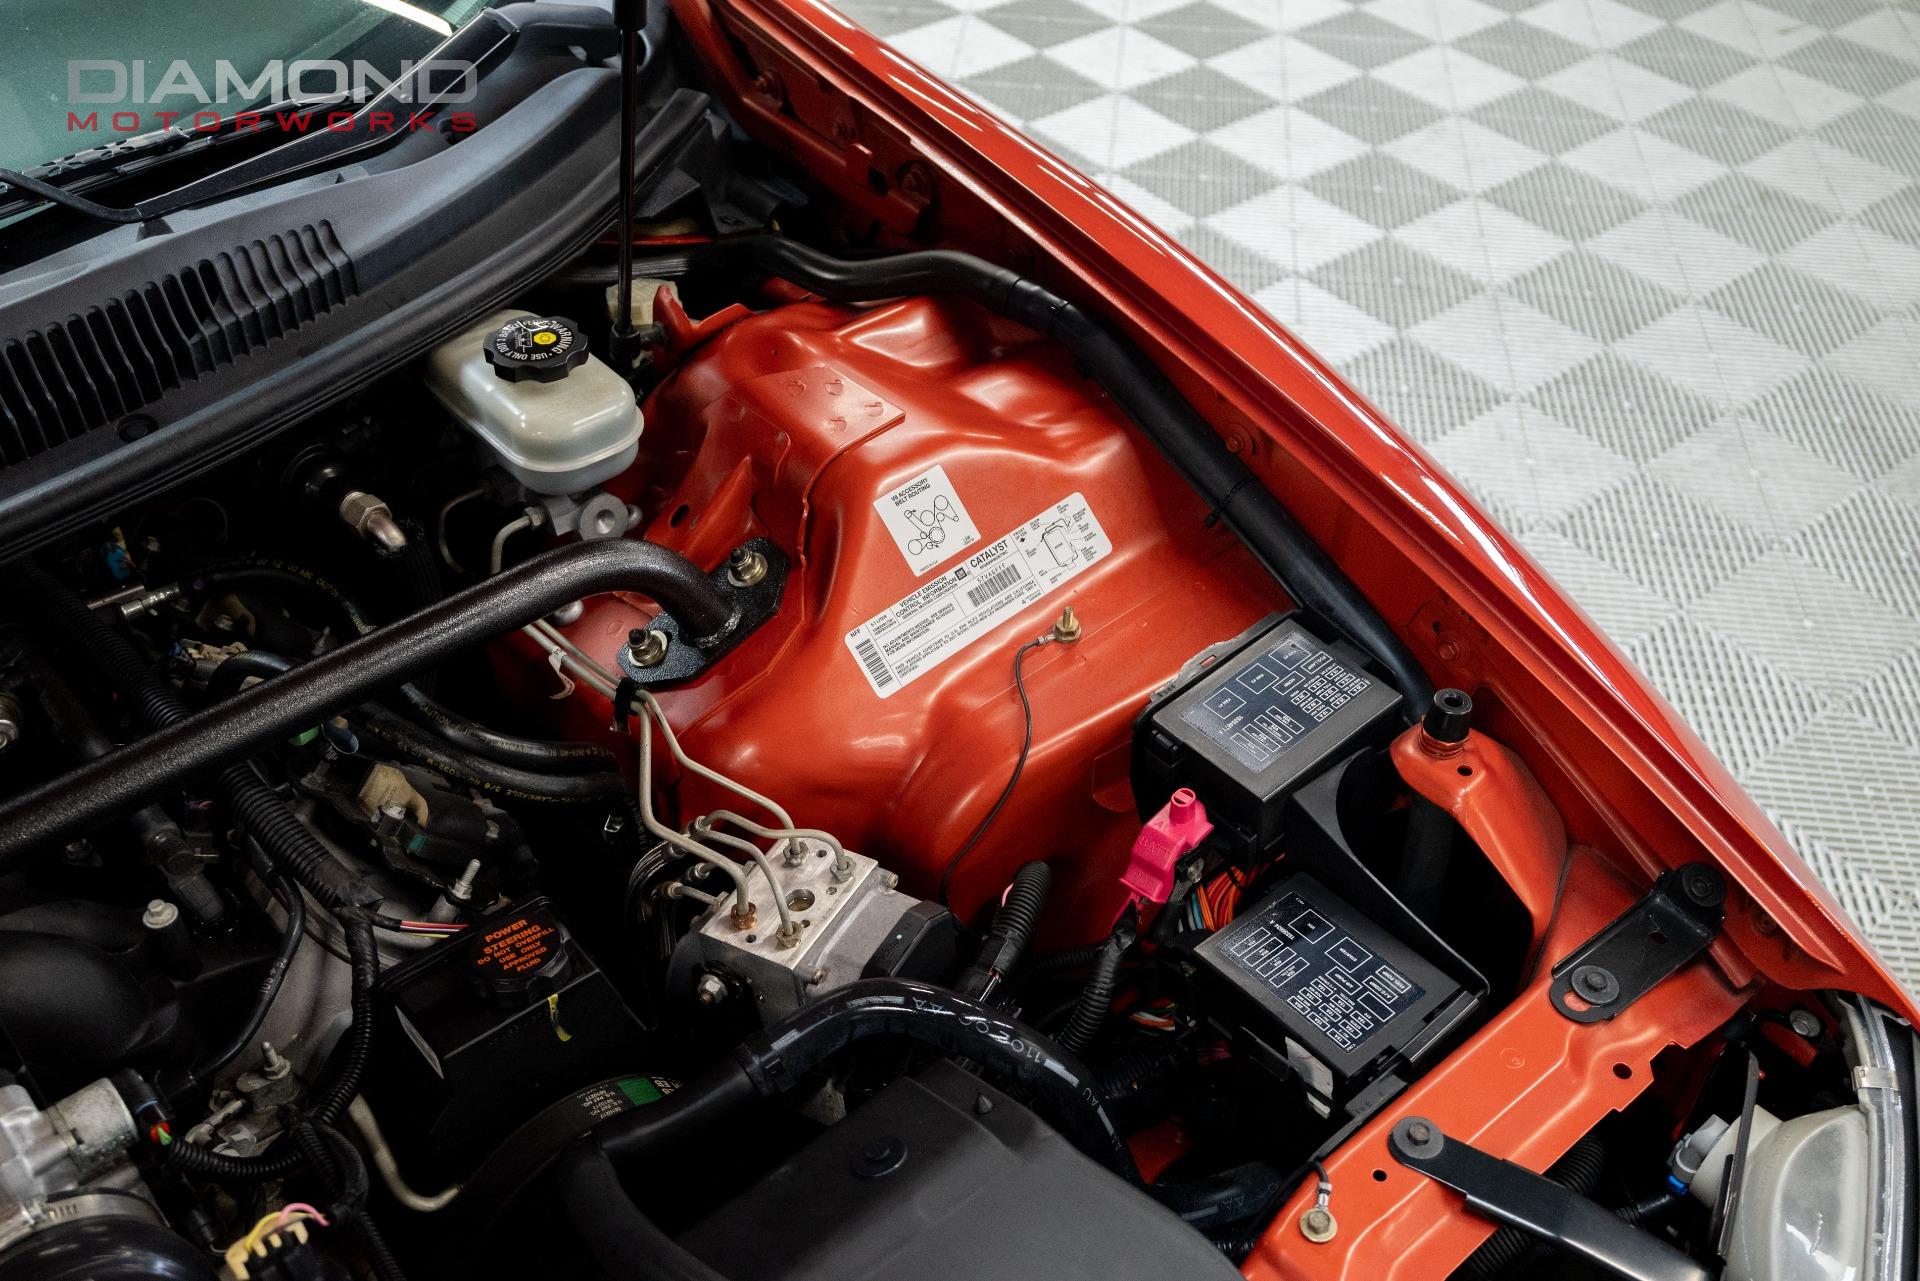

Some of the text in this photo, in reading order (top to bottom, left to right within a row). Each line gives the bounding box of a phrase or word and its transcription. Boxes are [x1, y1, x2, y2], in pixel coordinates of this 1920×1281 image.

[497, 343, 509, 353] DOT
[549, 320, 573, 354] WARNING
[505, 351, 528, 360] ONLY
[894, 482, 931, 506] BELT ROUTING
[897, 477, 928, 497] ACCESSORY
[969, 539, 1009, 568] CATALYST
[894, 576, 957, 618] CONTROL INFORMATION
[898, 574, 948, 608] VEHICLE EMISSION
[1283, 677, 1295, 687] HORN
[483, 924, 541, 954] STEERING
[484, 919, 528, 943] POWER
[477, 927, 555, 965] DO NOT OVERFILL
[499, 940, 541, 963] USE ONLY
[1339, 947, 1357, 961] STARTER
[503, 946, 547, 970] APPROVED
[516, 957, 541, 971] FLUID
[1334, 972, 1346, 982] PUMP
[1368, 980, 1382, 991] COMP
[1381, 970, 1406, 989] FUEL PUMP
